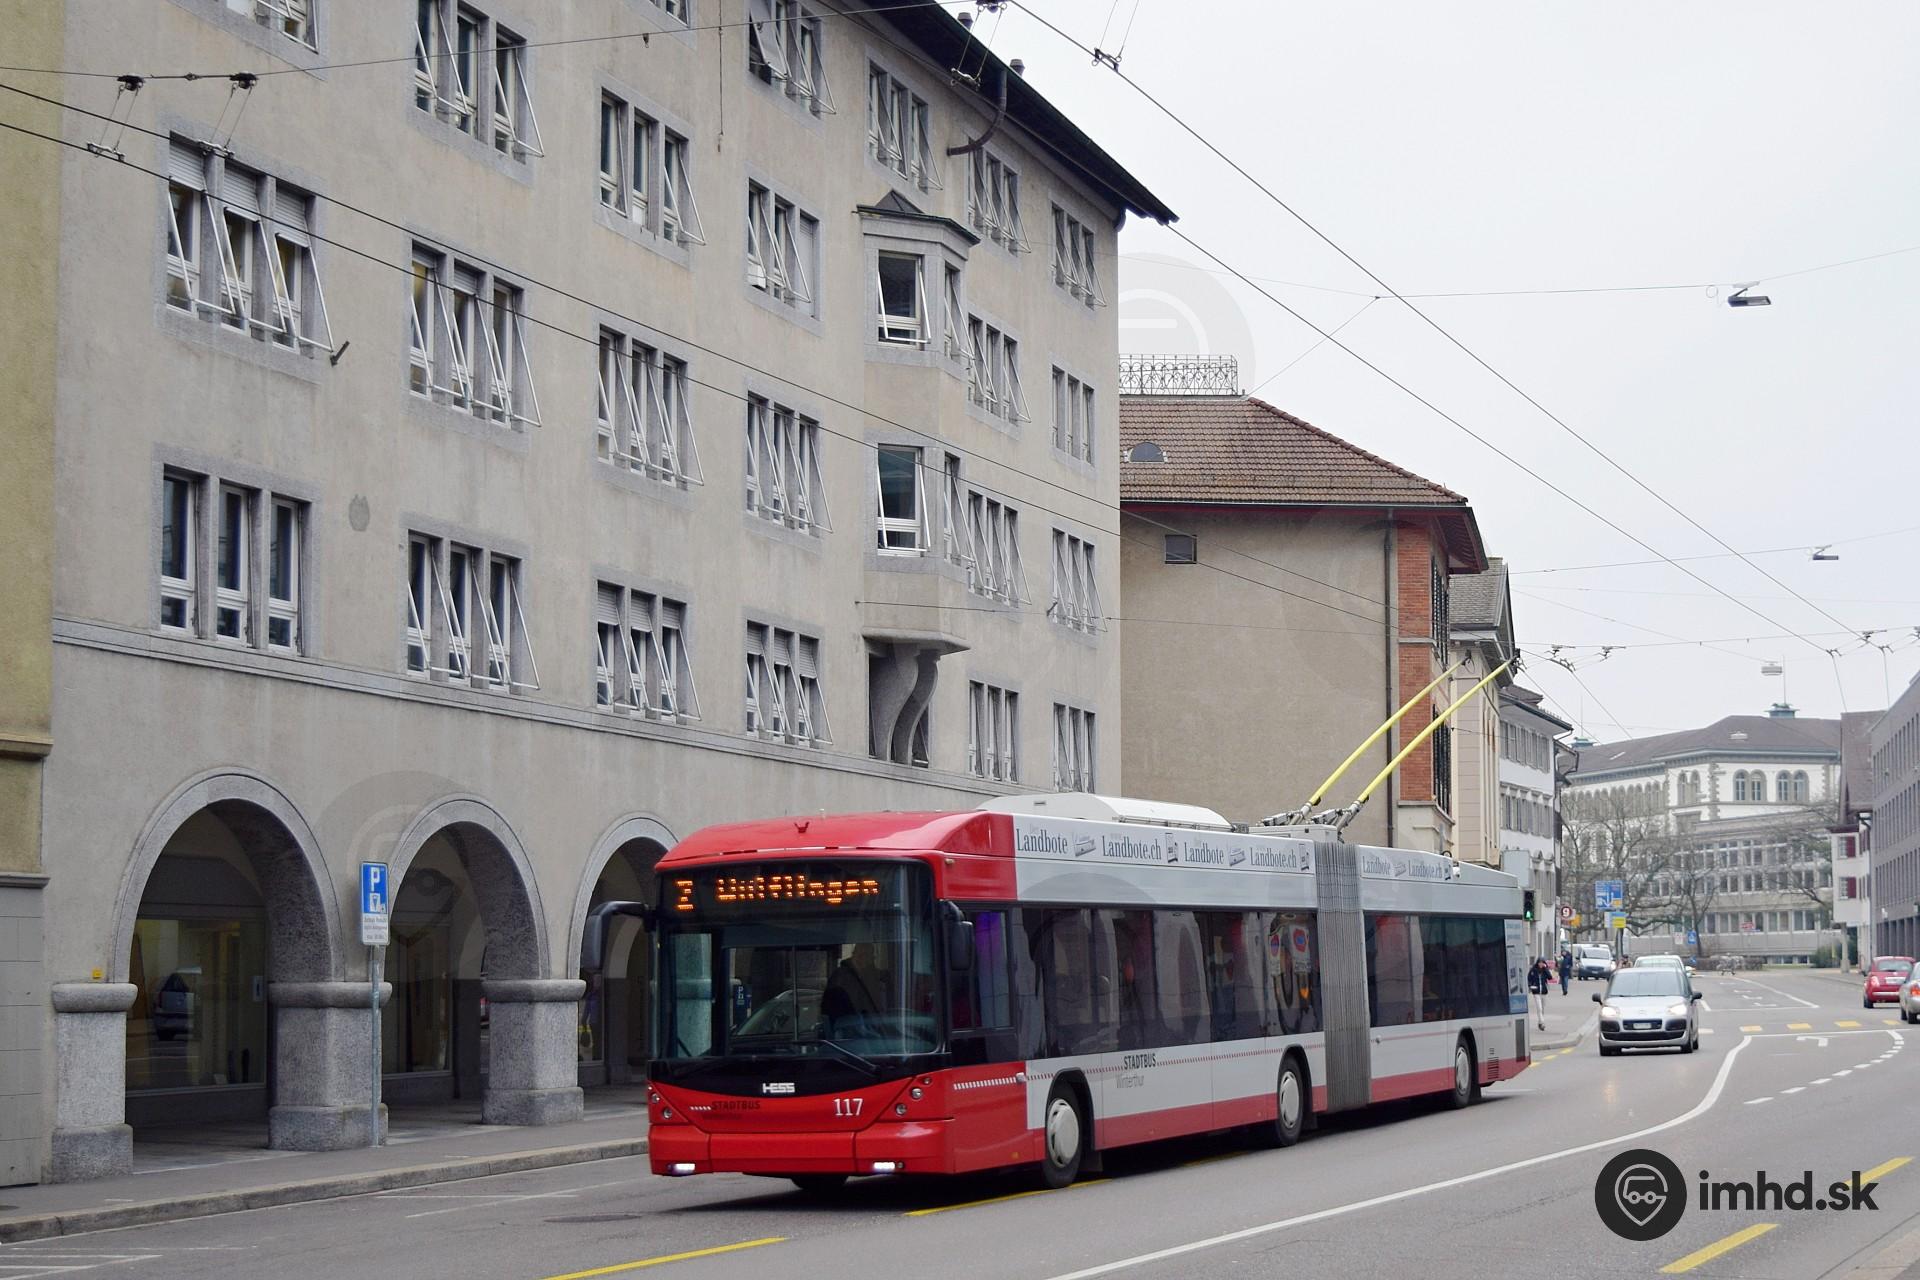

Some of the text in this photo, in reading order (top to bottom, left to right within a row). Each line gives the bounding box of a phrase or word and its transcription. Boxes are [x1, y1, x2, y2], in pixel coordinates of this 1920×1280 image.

[1016, 828, 1068, 854] Landbote
[1102, 835, 1161, 860] Landbote.ch
[1184, 842, 1224, 864] Landbote
[1250, 847, 1297, 869] Landbote.ch
[370, 866, 380, 892] P
[1124, 1053, 1156, 1070] STADTBUS
[762, 1082, 795, 1094] HESS
[711, 1100, 761, 1111] STADTBUS
[833, 1098, 863, 1117] 117
